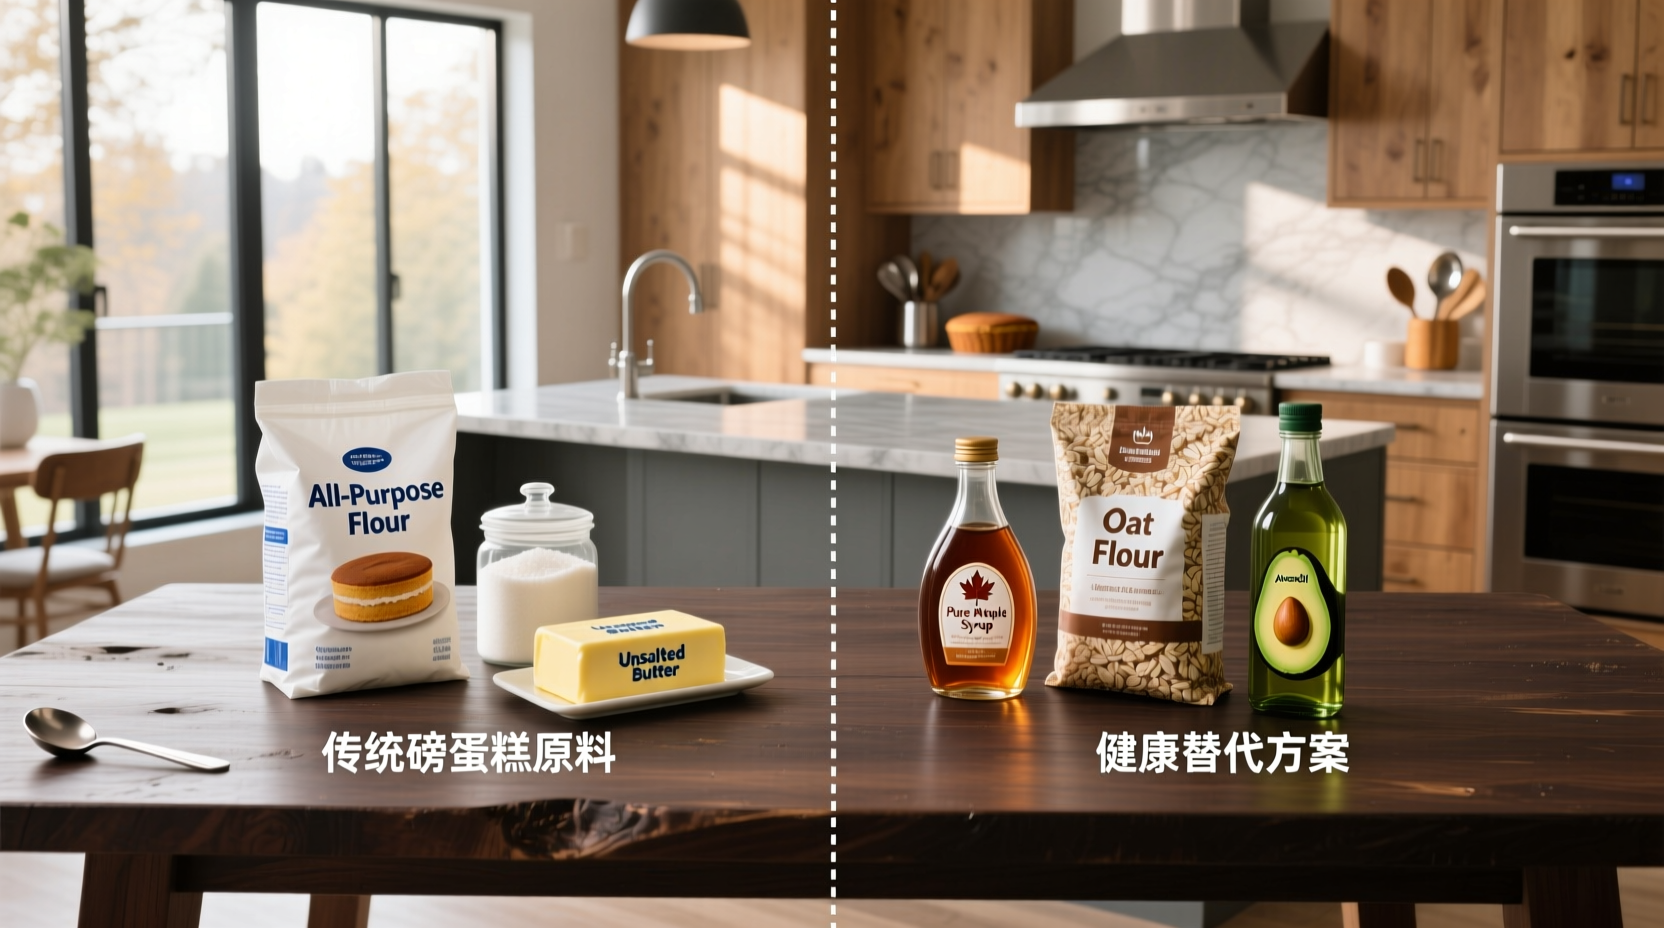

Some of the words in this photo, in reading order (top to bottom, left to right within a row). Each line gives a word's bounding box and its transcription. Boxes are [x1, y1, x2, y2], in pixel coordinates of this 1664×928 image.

[308, 481, 444, 510] All-Purpose
[348, 511, 411, 535] Flour
[1102, 507, 1155, 536] Oat
[1092, 539, 1164, 569] Flour
[946, 606, 970, 618] Pure
[960, 619, 994, 634] Syrup
[618, 643, 685, 668] Unsalted
[632, 664, 680, 682] Butter
